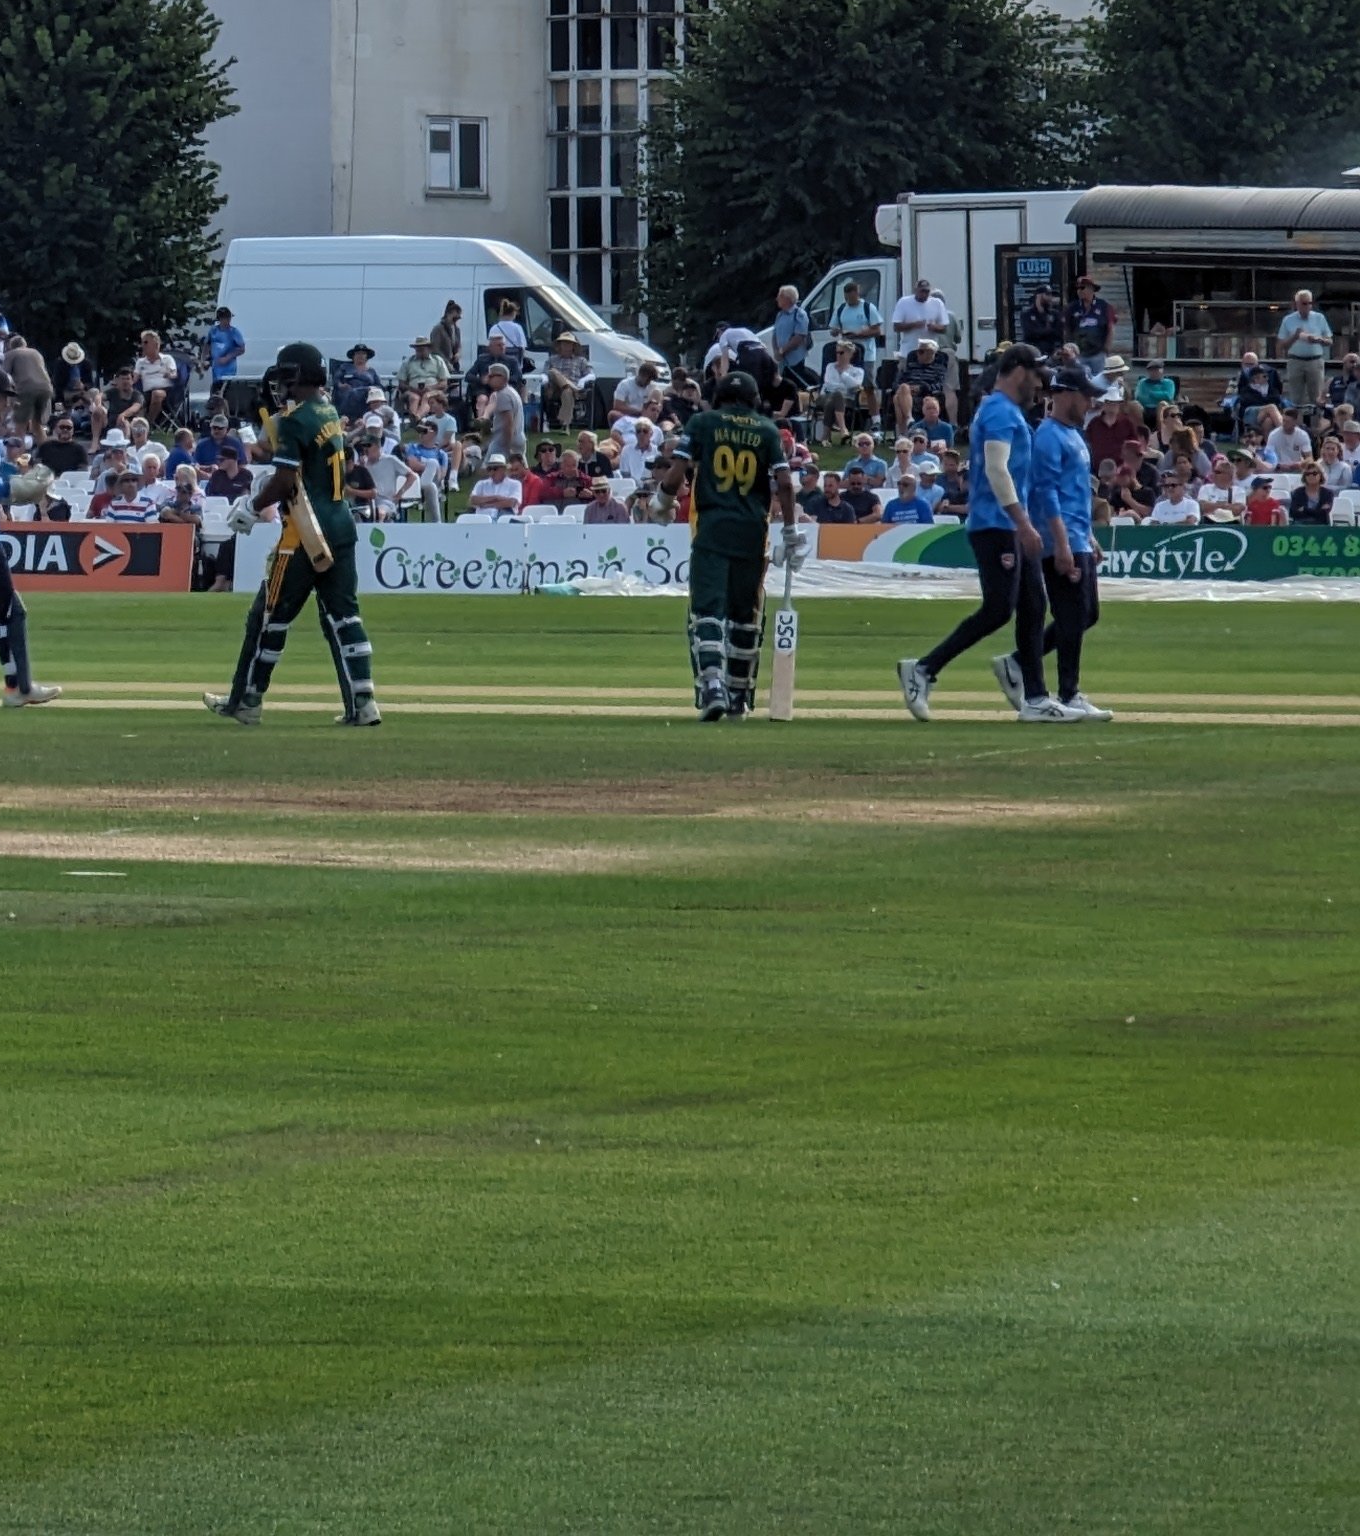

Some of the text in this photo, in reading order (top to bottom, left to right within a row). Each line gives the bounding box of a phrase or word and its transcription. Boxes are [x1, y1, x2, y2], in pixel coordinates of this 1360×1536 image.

[713, 445, 757, 496] 99
[1272, 535, 1339, 557] 0344
[778, 615, 794, 648] DSC
